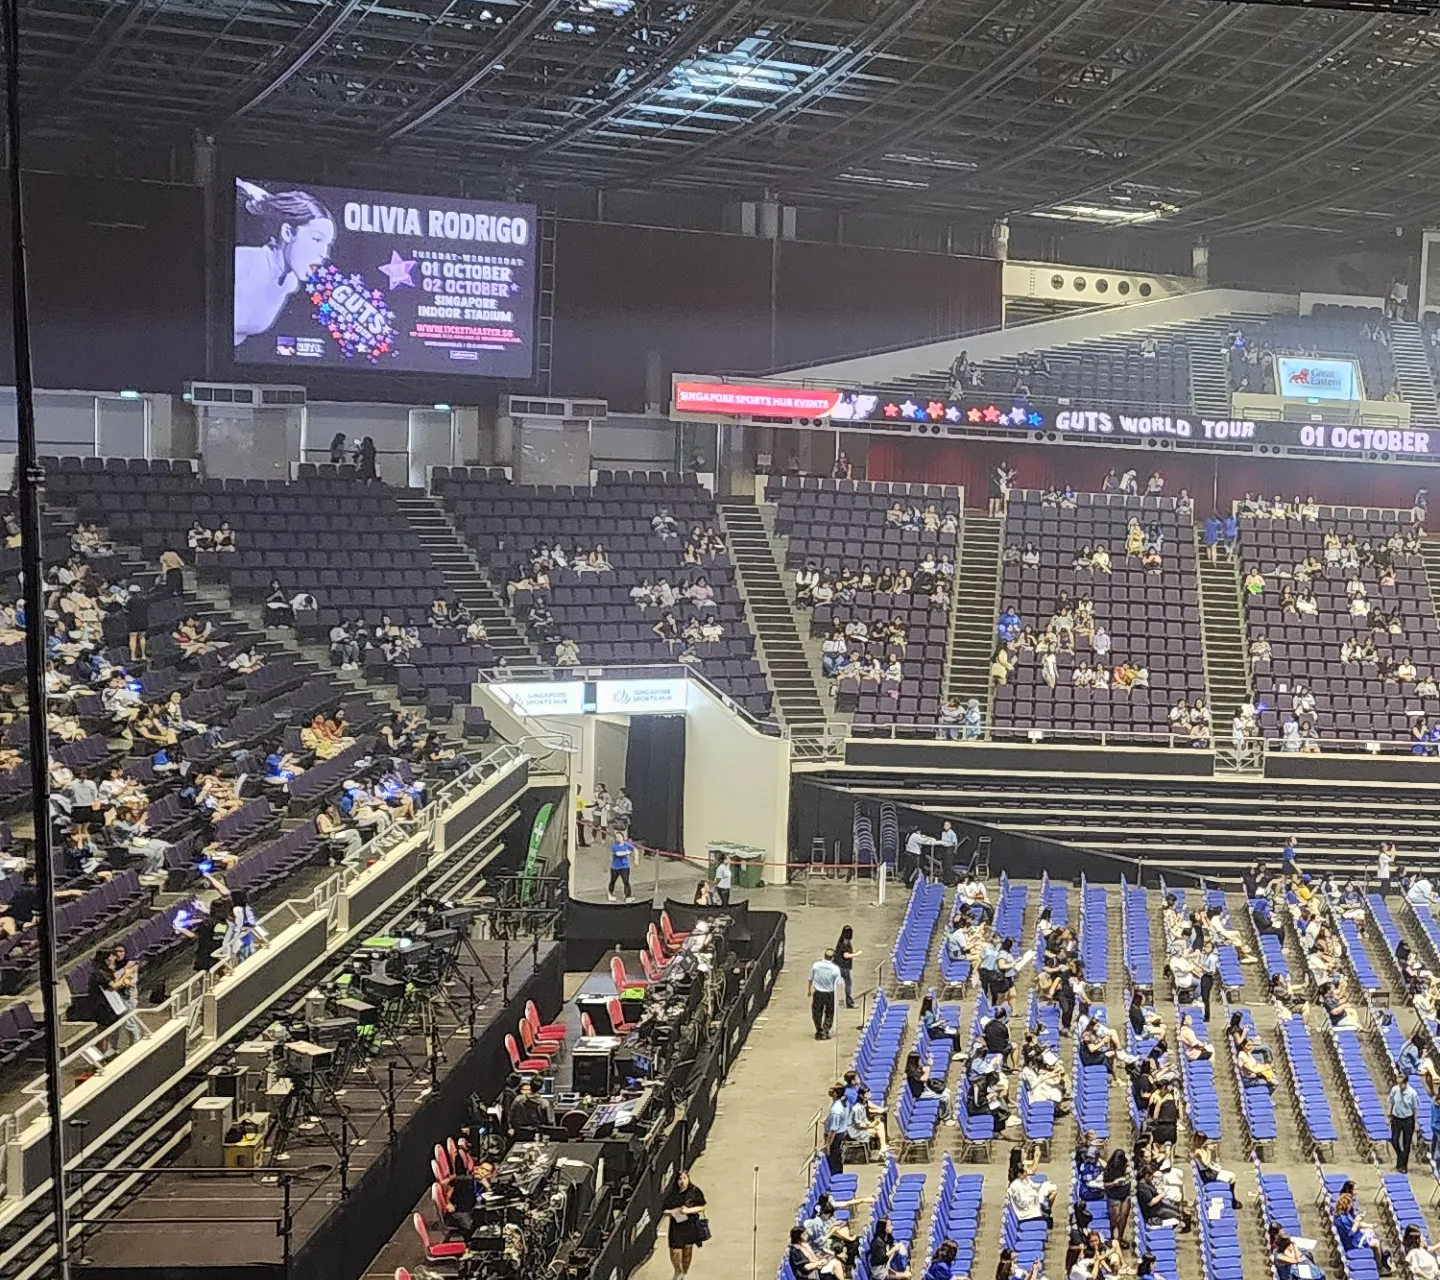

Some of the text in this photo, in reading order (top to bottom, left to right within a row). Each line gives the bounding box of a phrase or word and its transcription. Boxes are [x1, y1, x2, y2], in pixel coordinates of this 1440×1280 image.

[344, 202, 529, 246] OLIVIA RODRIGO
[421, 261, 512, 282] 01 OCTOBER
[422, 278, 509, 298] 02 OCTOBER
[332, 285, 386, 335] GUTS
[434, 294, 498, 309] SINGAPORE
[418, 305, 514, 323] INDOOR STADIUM
[1311, 368, 1335, 378] Great
[1311, 377, 1341, 387] Eastern
[680, 390, 829, 409] SINGAPORE SPORTS HUB EVENTS
[1055, 410, 1113, 433] GUTS
[1119, 415, 1191, 436] WORLD
[1202, 419, 1255, 439] TOUR
[1300, 425, 1325, 447] 01
[1330, 427, 1429, 453] OCTOBER
